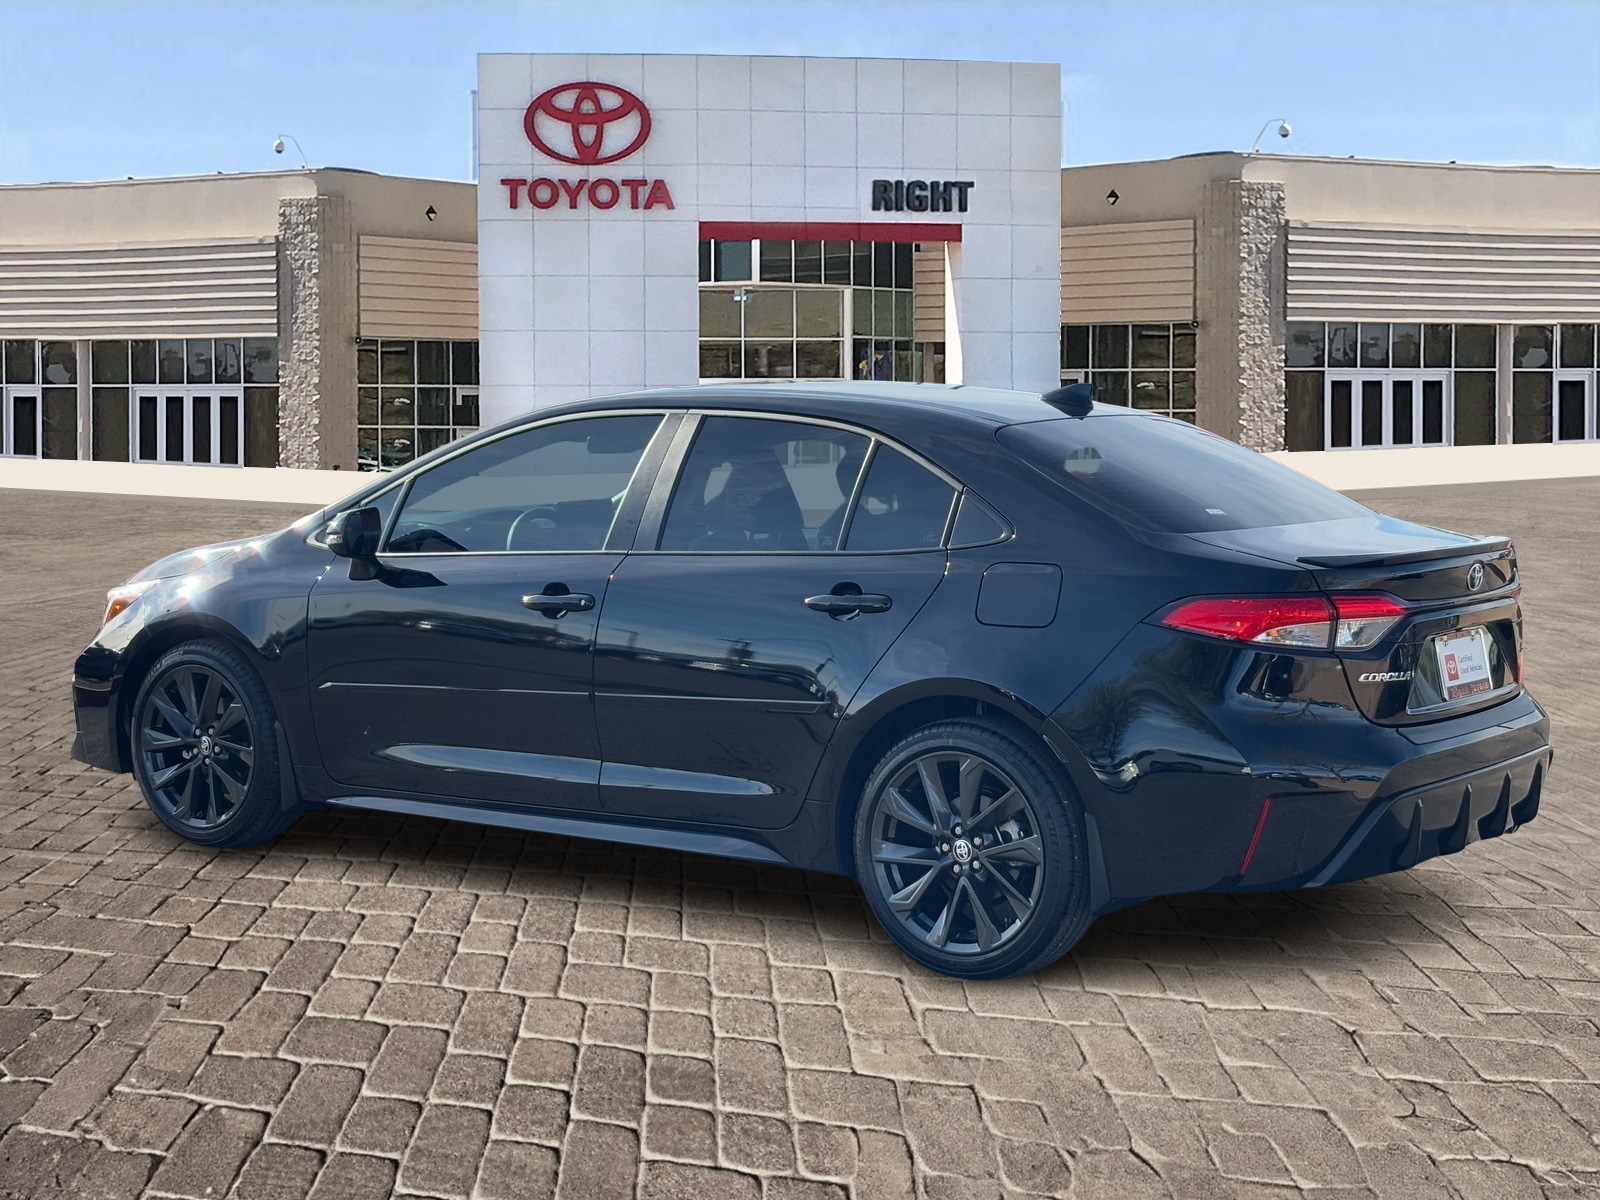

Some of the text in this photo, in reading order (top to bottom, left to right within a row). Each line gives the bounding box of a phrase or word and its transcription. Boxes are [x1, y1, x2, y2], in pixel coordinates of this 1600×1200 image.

[500, 178, 675, 210] TOYOTA
[872, 180, 975, 212] RIGHT
[1358, 670, 1413, 682] COROLLA
